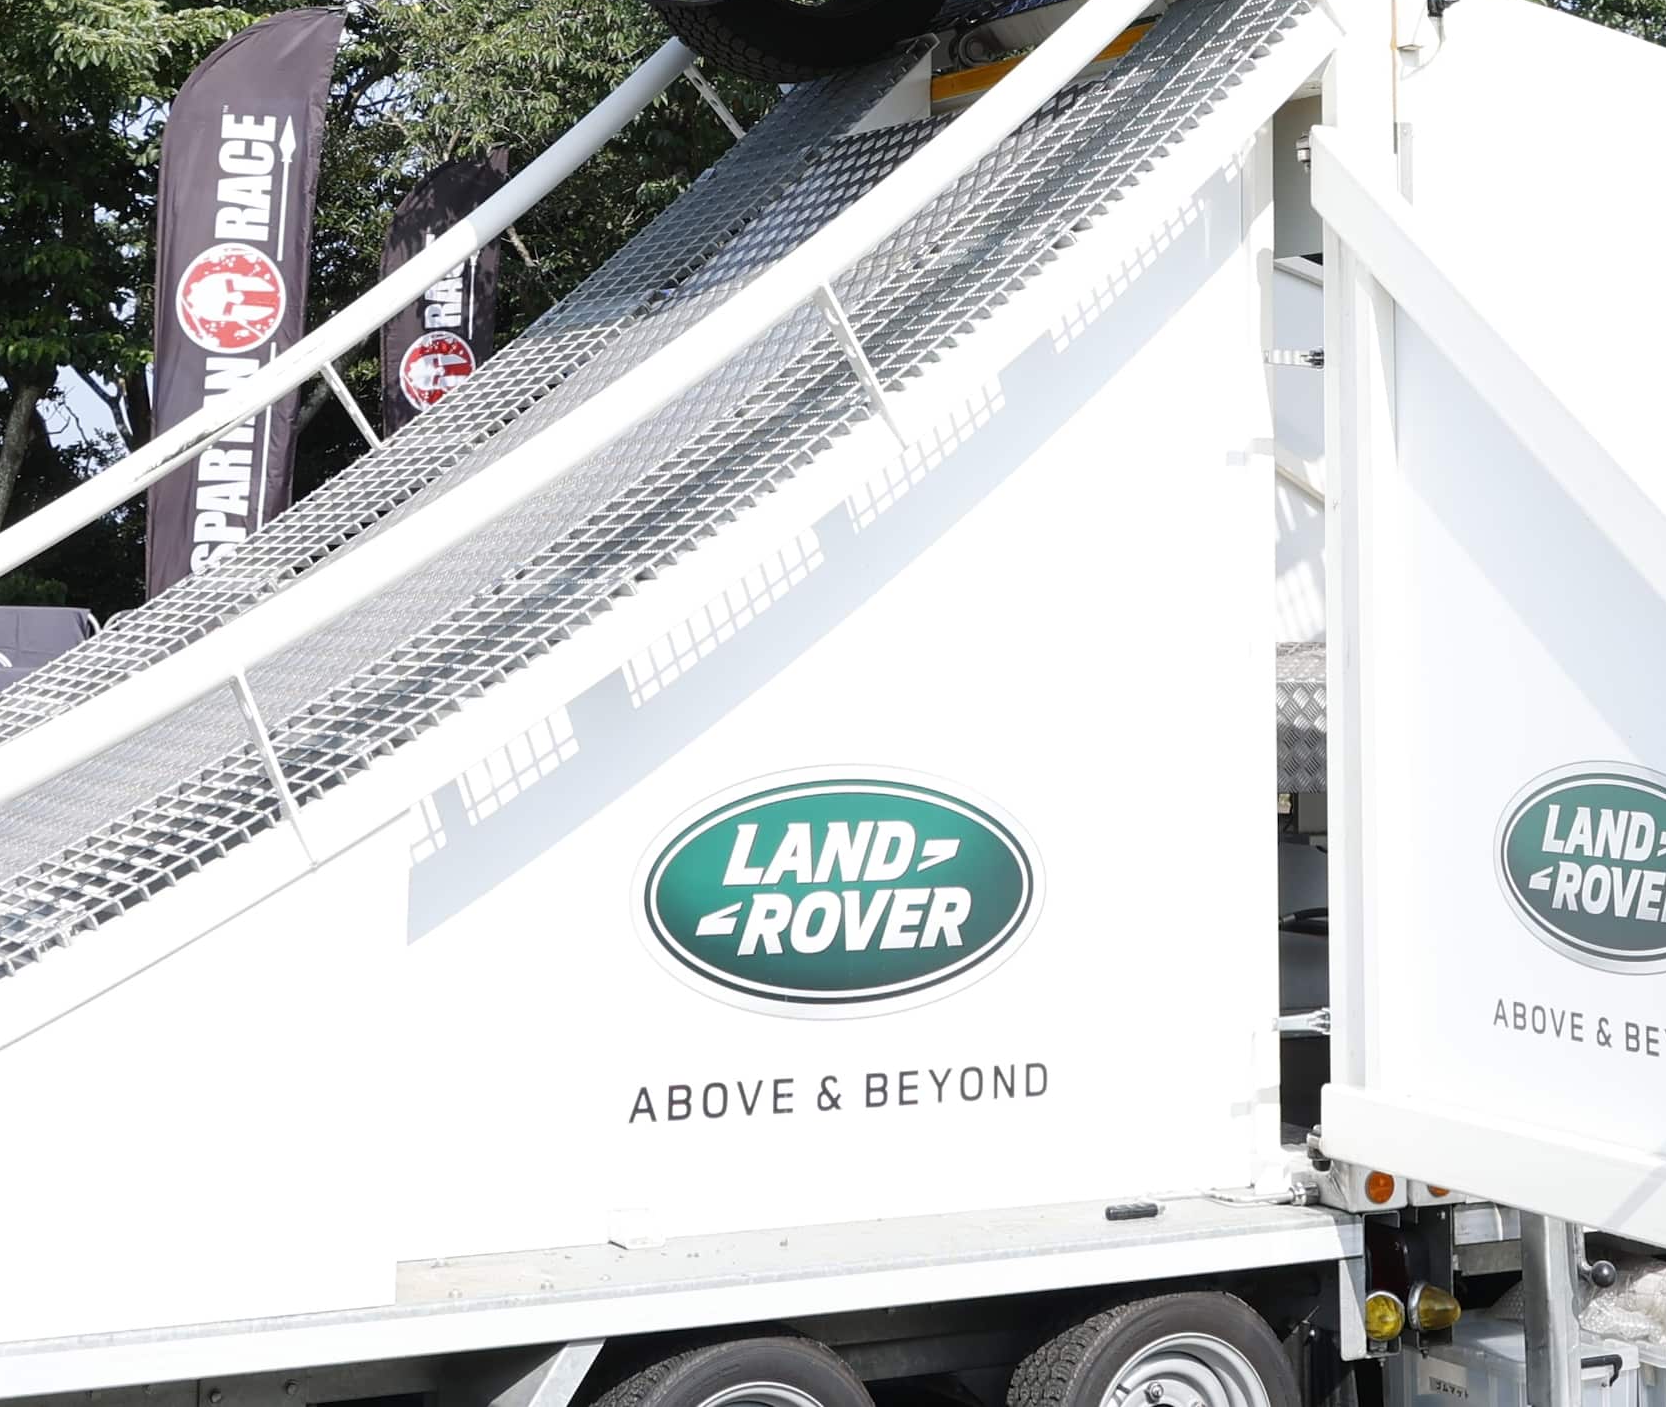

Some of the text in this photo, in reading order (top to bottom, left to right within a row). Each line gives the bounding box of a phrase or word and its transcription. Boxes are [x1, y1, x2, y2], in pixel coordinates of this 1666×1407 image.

[214, 114, 277, 242] RACE
[722, 820, 917, 887] LAND
[1541, 803, 1656, 862] LAND
[736, 886, 973, 957] ROVER
[1493, 997, 1585, 1043] ABOVE
[1595, 1016, 1613, 1049] &
[629, 1061, 1049, 1124] ABOVE & BEYOND
